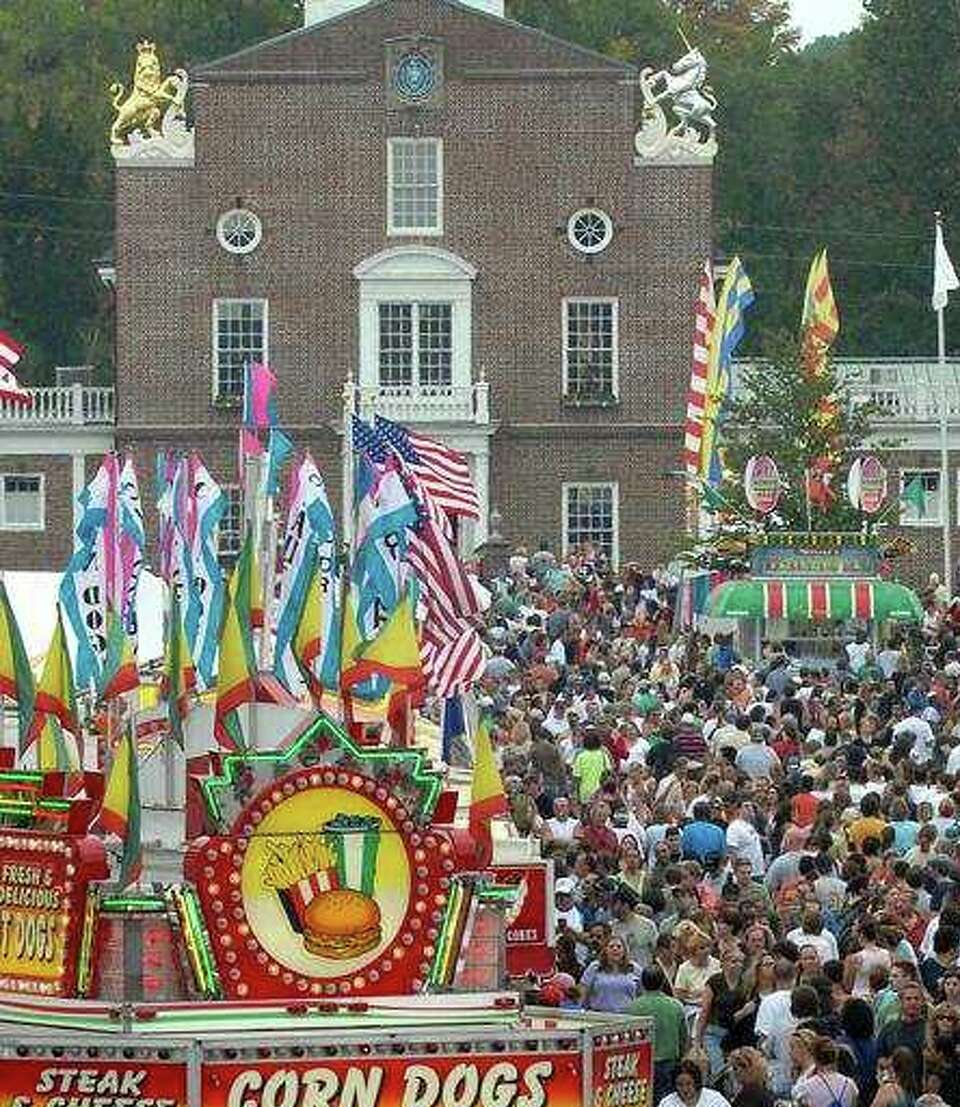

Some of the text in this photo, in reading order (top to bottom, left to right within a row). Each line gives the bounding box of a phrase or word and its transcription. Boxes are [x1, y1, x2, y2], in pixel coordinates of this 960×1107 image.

[604, 1054, 640, 1078] STEAK
[36, 1067, 147, 1096] STEAK
[606, 1079, 647, 1107] CHEESE
